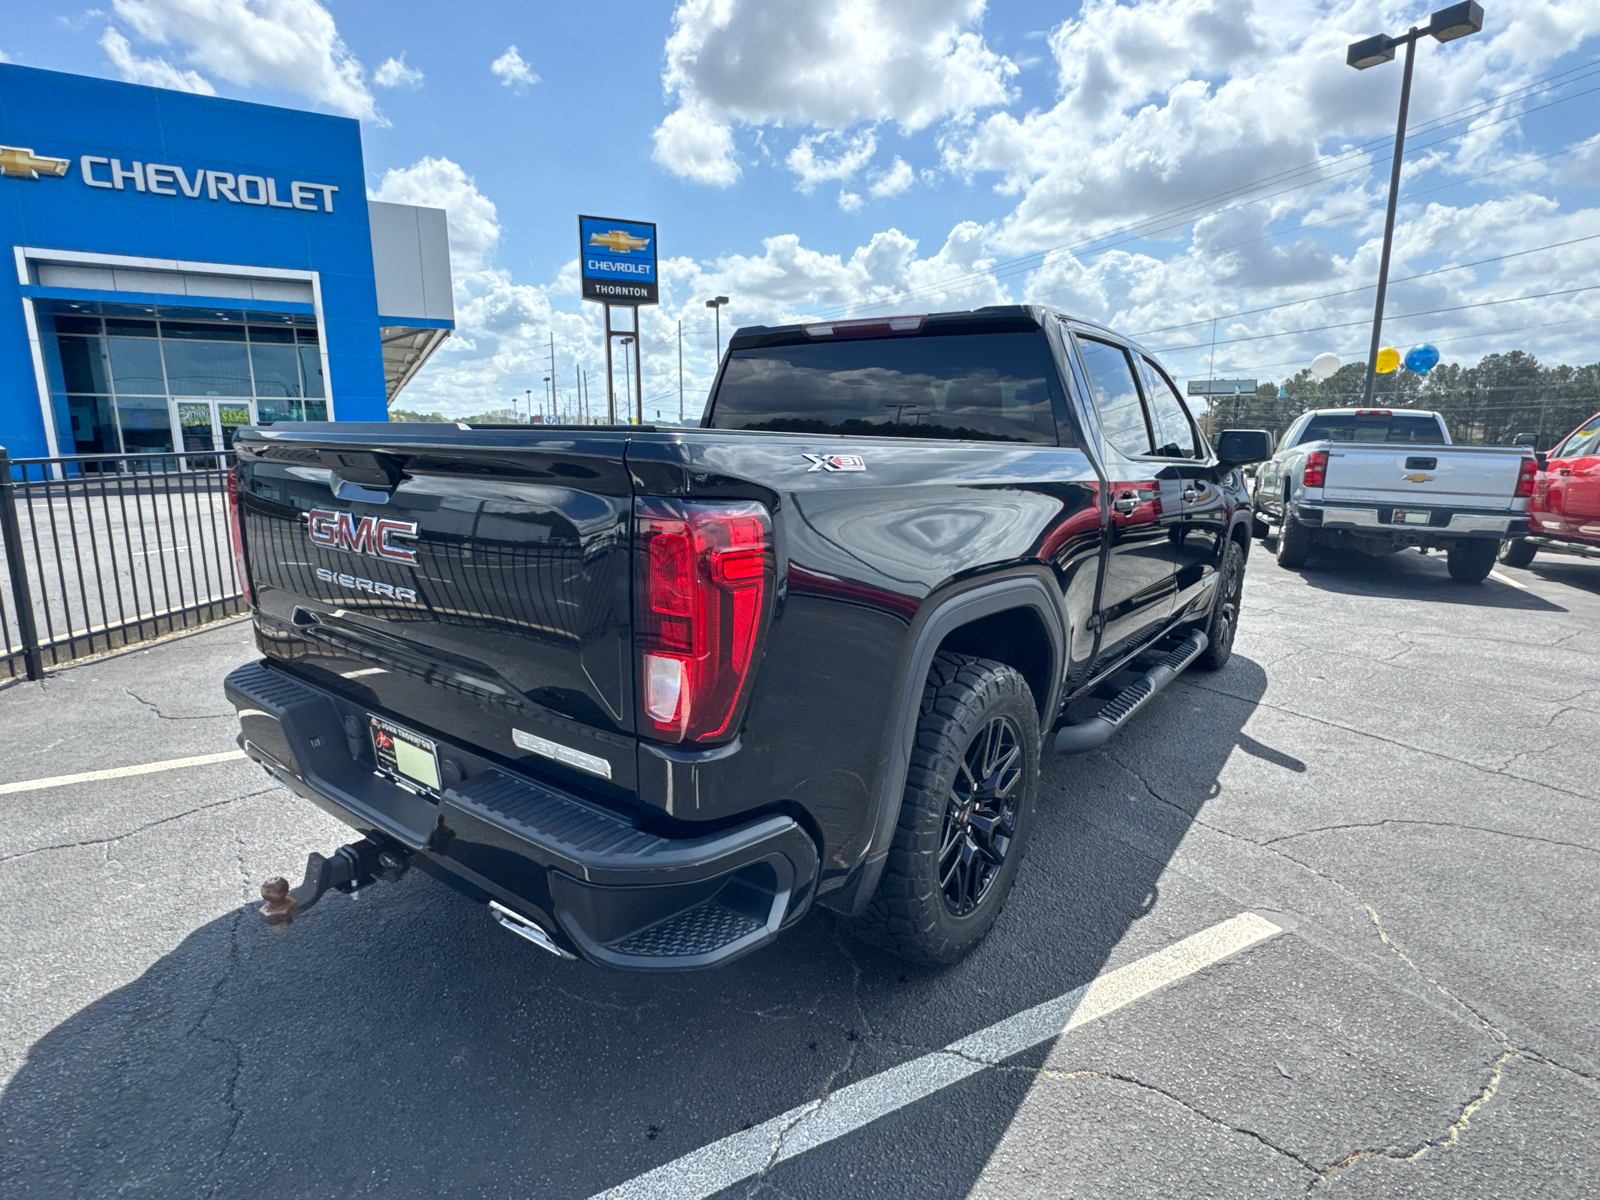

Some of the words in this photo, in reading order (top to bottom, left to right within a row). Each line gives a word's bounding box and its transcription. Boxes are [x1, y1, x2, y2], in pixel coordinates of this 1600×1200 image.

[80, 155, 339, 213] CHEVROLET
[588, 259, 651, 275] CHEVROLET
[595, 284, 648, 297] THORNTON
[308, 508, 418, 564] GMC
[316, 568, 417, 603] SIERRA
[381, 721, 398, 735] JOHN
[397, 728, 432, 751] THORNTON
[519, 735, 605, 773] ELEVATION
